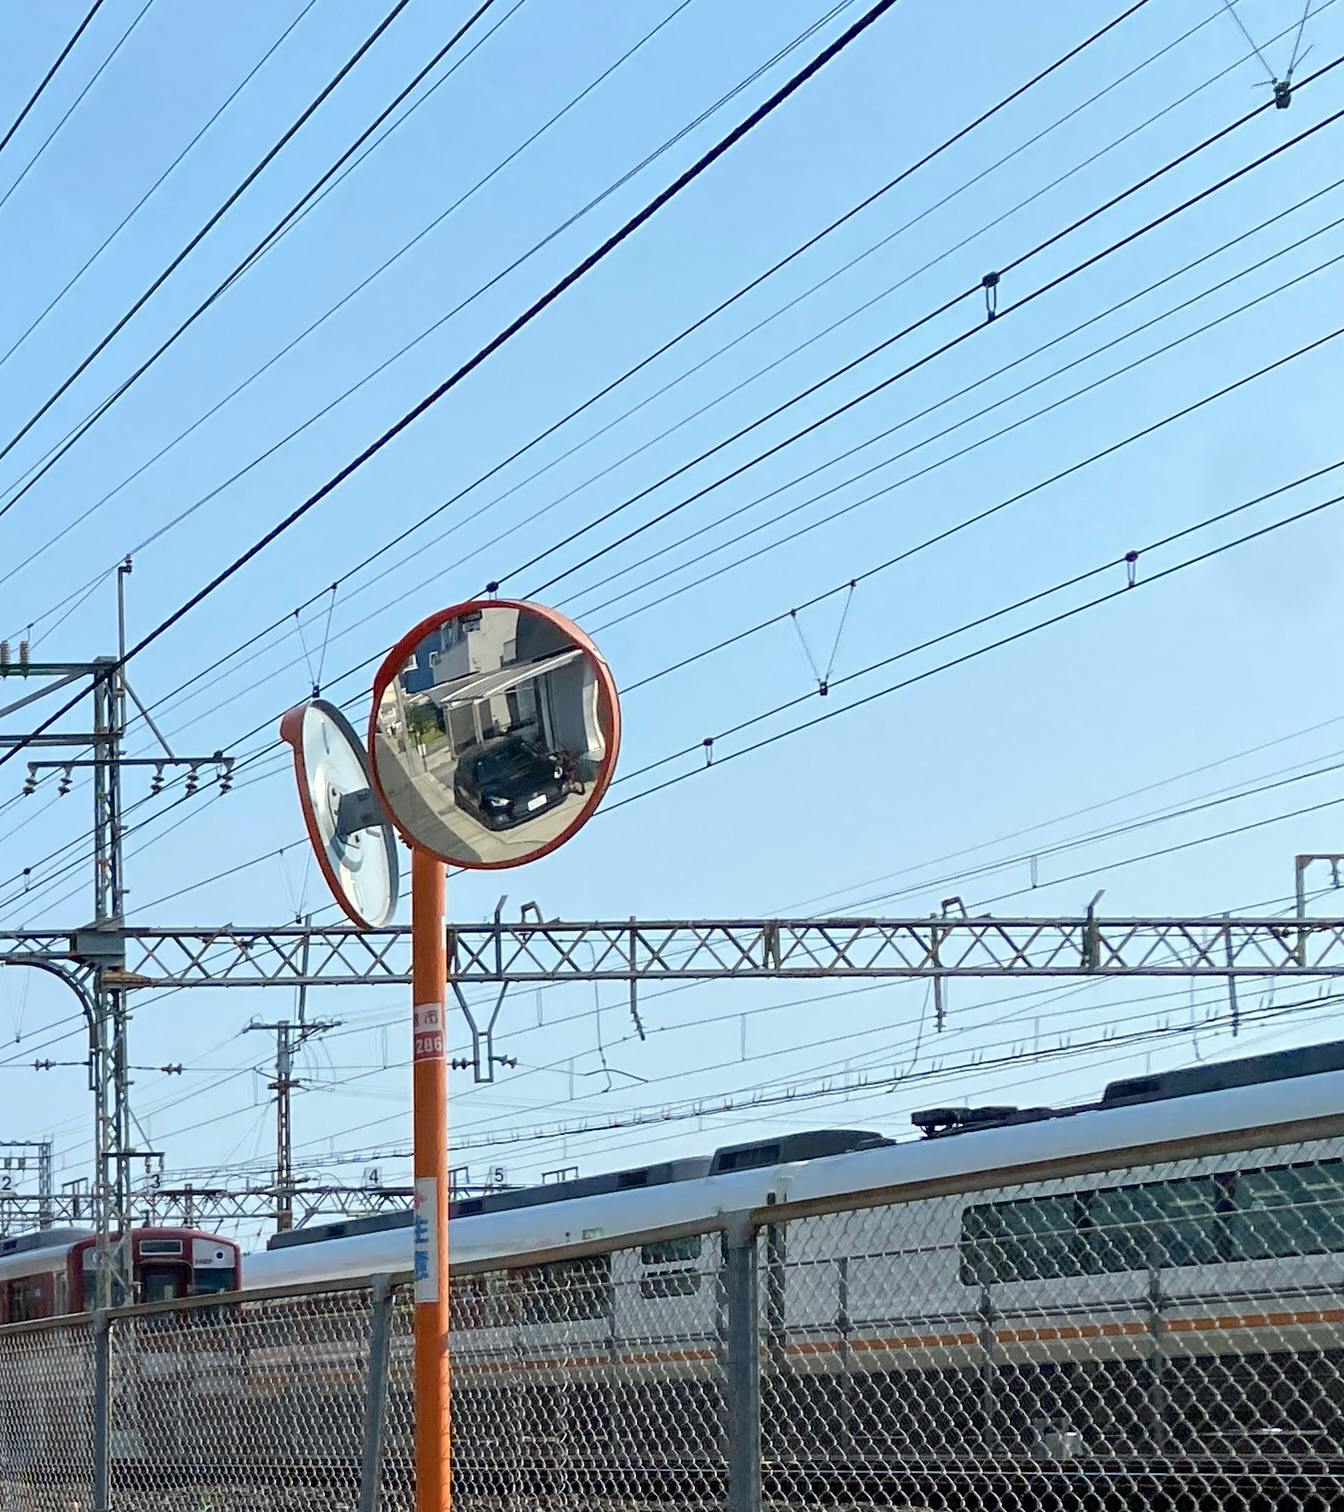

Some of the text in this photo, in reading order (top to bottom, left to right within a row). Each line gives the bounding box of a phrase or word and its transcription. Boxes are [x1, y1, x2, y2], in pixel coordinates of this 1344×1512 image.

[151, 1174, 161, 1189] 3
[369, 1168, 379, 1184] 4
[494, 1168, 504, 1183] 5
[1, 1176, 12, 1191] 2
